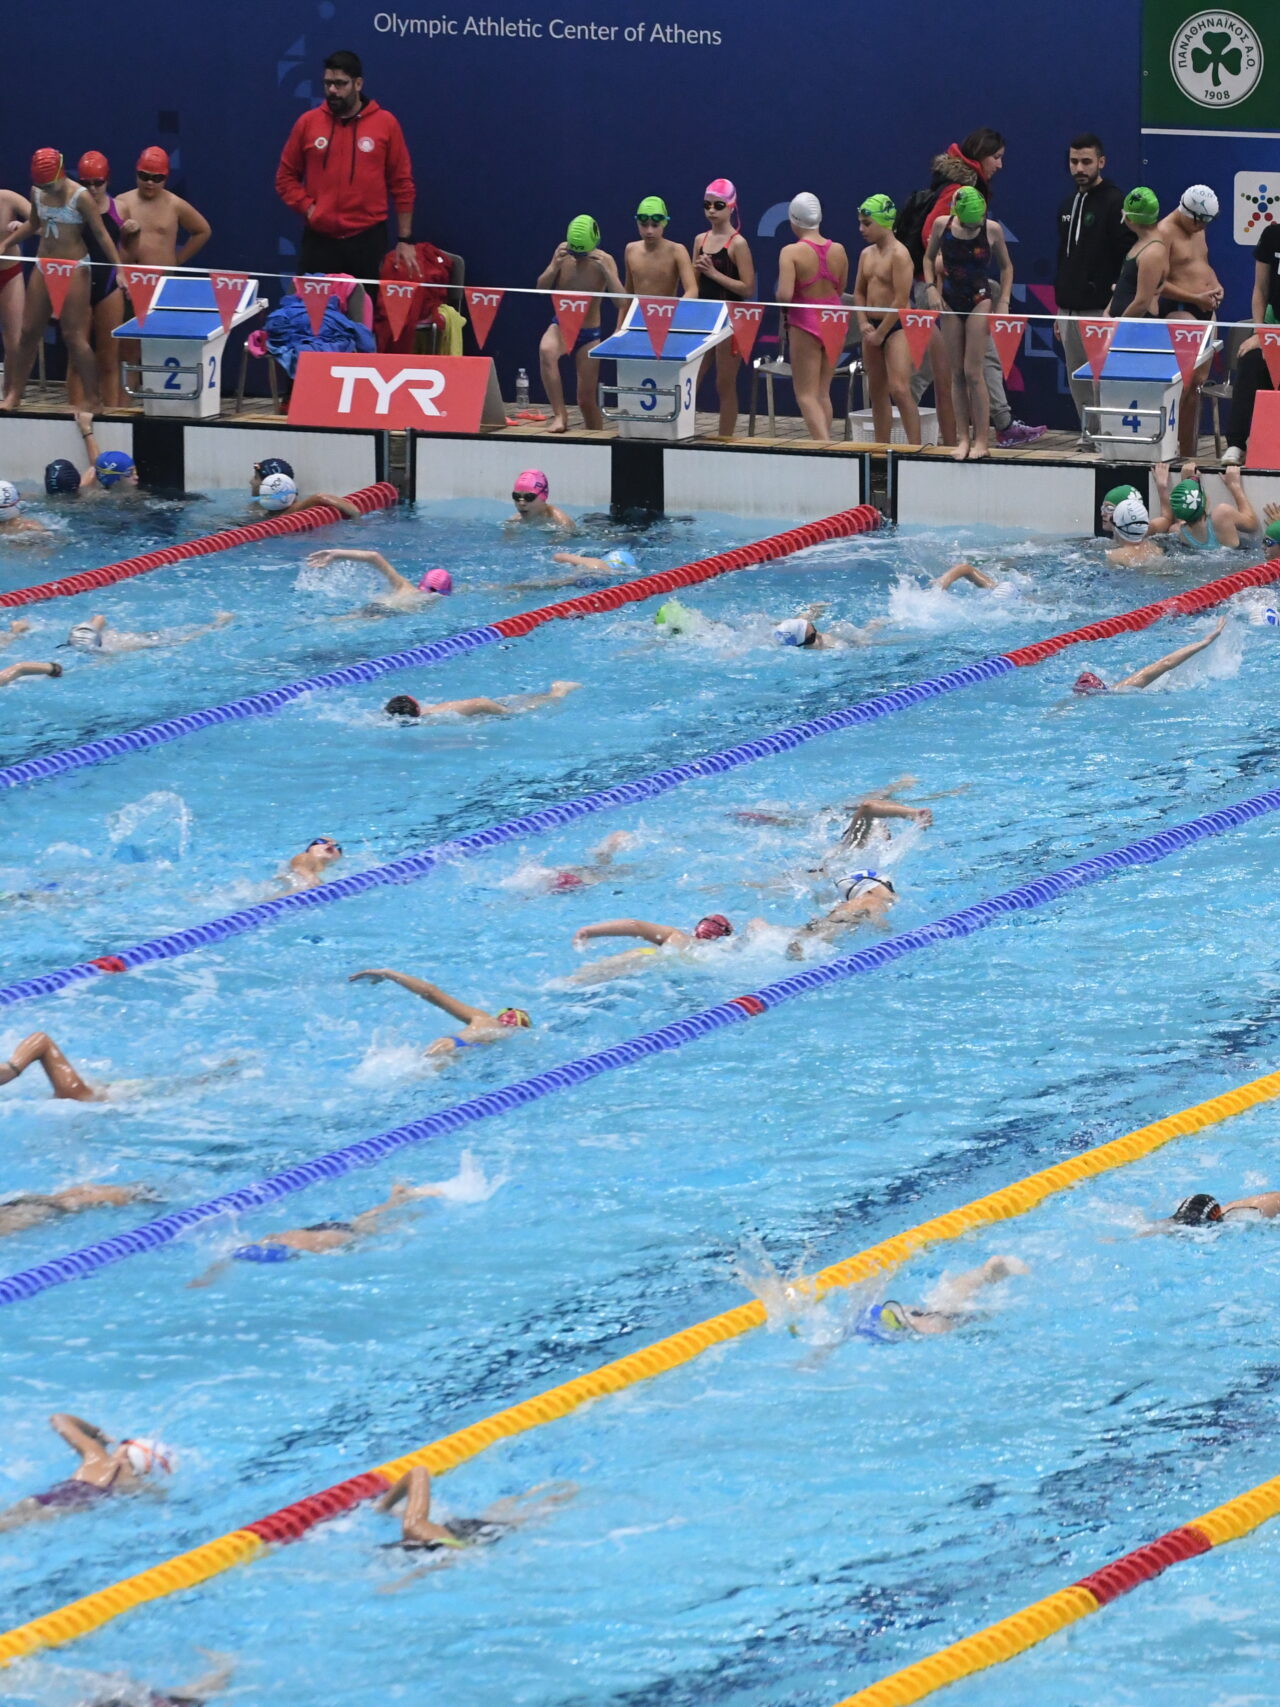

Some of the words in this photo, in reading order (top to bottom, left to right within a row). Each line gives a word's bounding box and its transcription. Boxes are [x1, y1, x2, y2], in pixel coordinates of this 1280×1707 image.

[374, 12, 458, 38] Olympic
[463, 16, 543, 38] Athletic
[549, 19, 619, 41] Center
[624, 22, 645, 42] of
[650, 23, 722, 45] Athens
[1204, 90, 1230, 101] 1908
[164, 357, 181, 390] 2
[208, 356, 216, 388] 2
[330, 366, 445, 416] TYR
[640, 378, 657, 411] 3
[684, 378, 692, 410] 3
[1122, 400, 1141, 433] 4
[1168, 398, 1175, 431] 4
